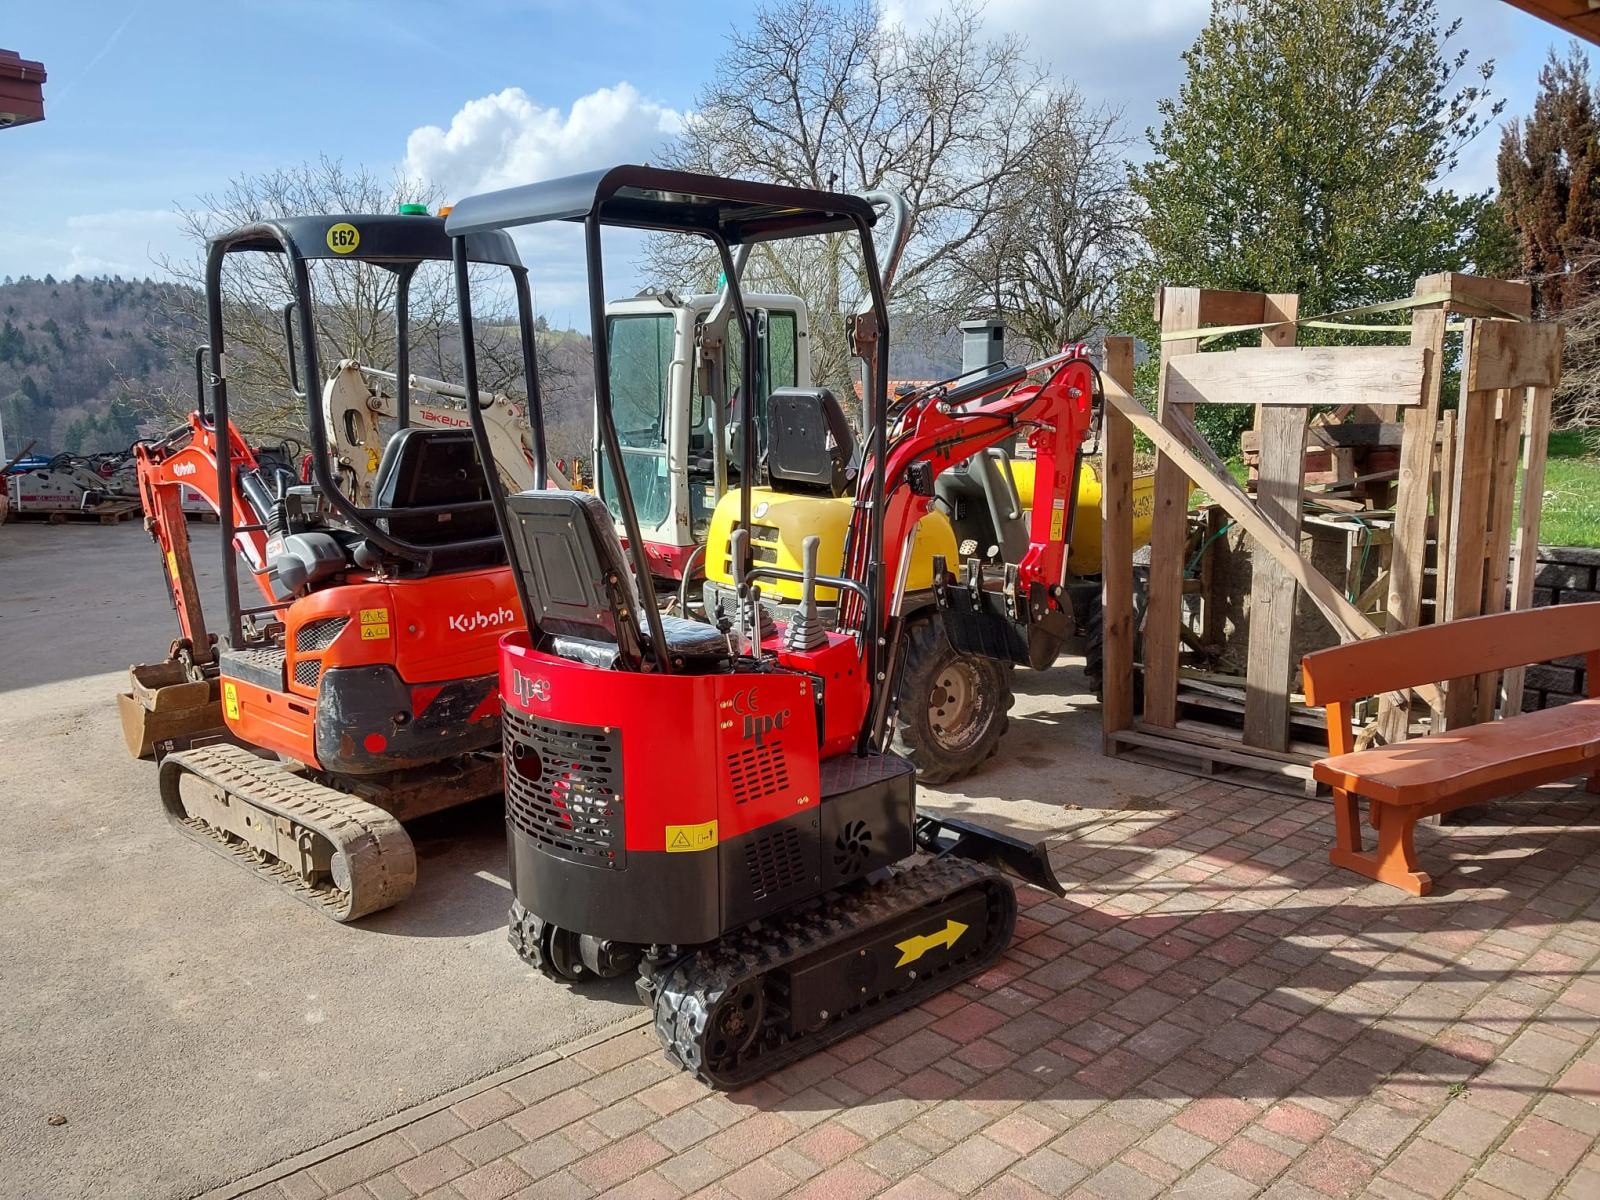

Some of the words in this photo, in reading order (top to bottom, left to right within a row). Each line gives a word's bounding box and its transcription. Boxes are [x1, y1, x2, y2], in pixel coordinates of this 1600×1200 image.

[331, 229, 356, 247] E62
[172, 461, 197, 477] Kubota
[449, 606, 514, 632] Kubota
[732, 686, 759, 715] CE
